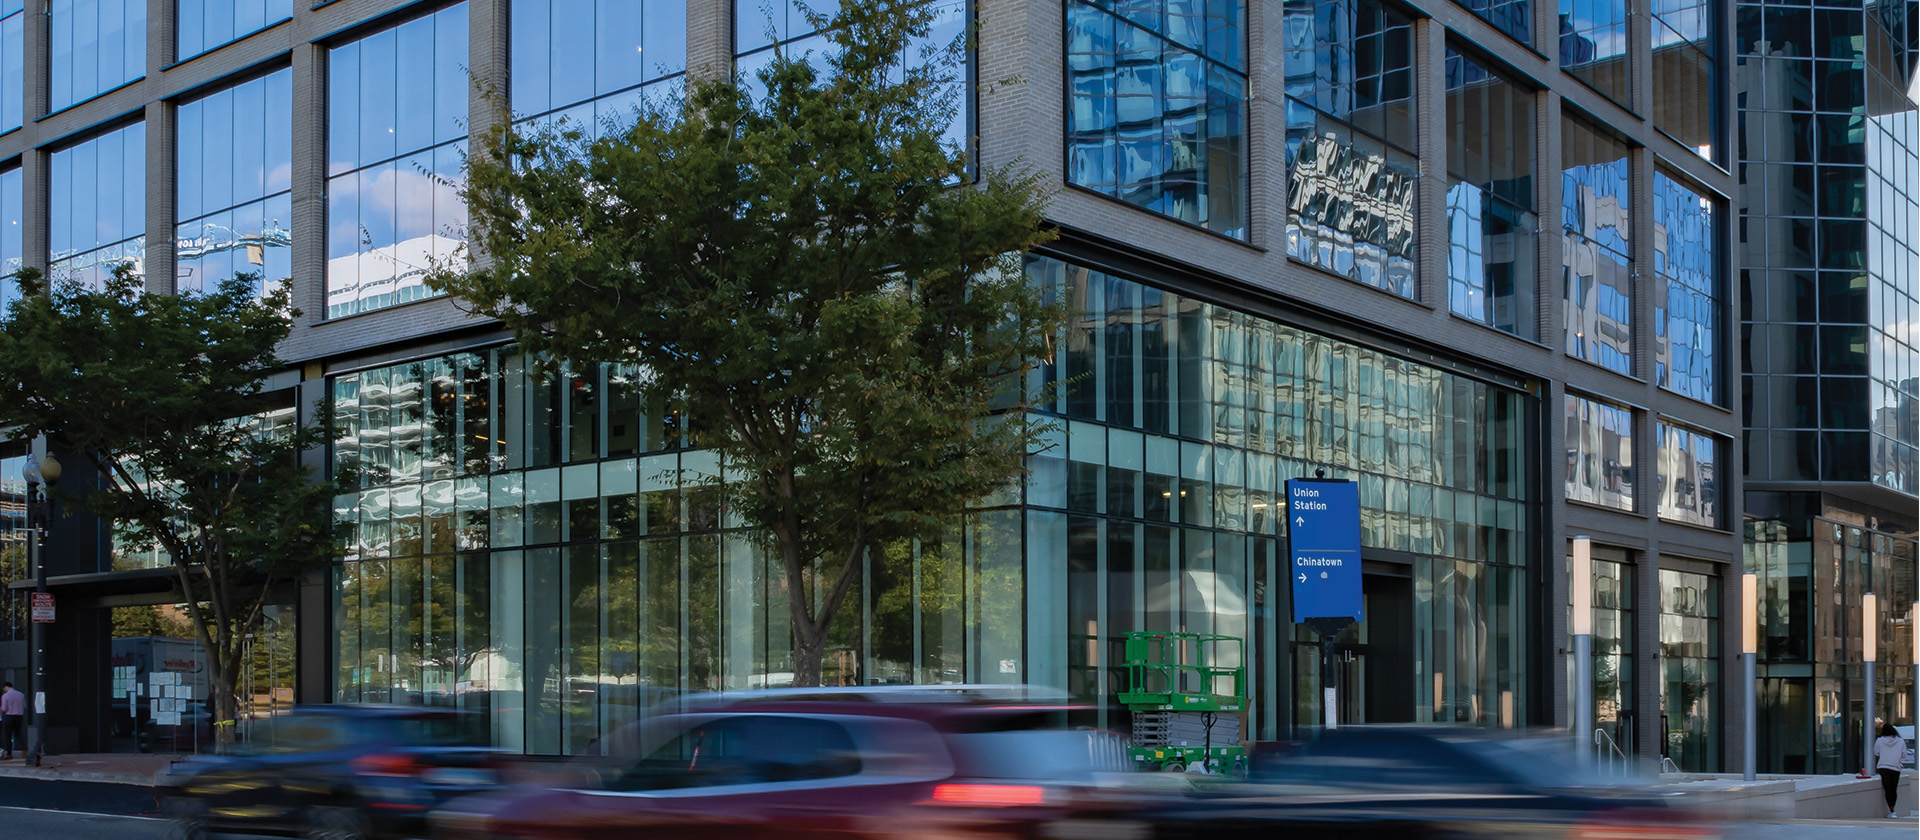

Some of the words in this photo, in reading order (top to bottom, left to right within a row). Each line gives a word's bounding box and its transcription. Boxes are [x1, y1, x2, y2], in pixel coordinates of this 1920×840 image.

[1293, 487, 1320, 498] Union
[1294, 500, 1327, 510] Station
[1297, 556, 1343, 567] Chinatown
